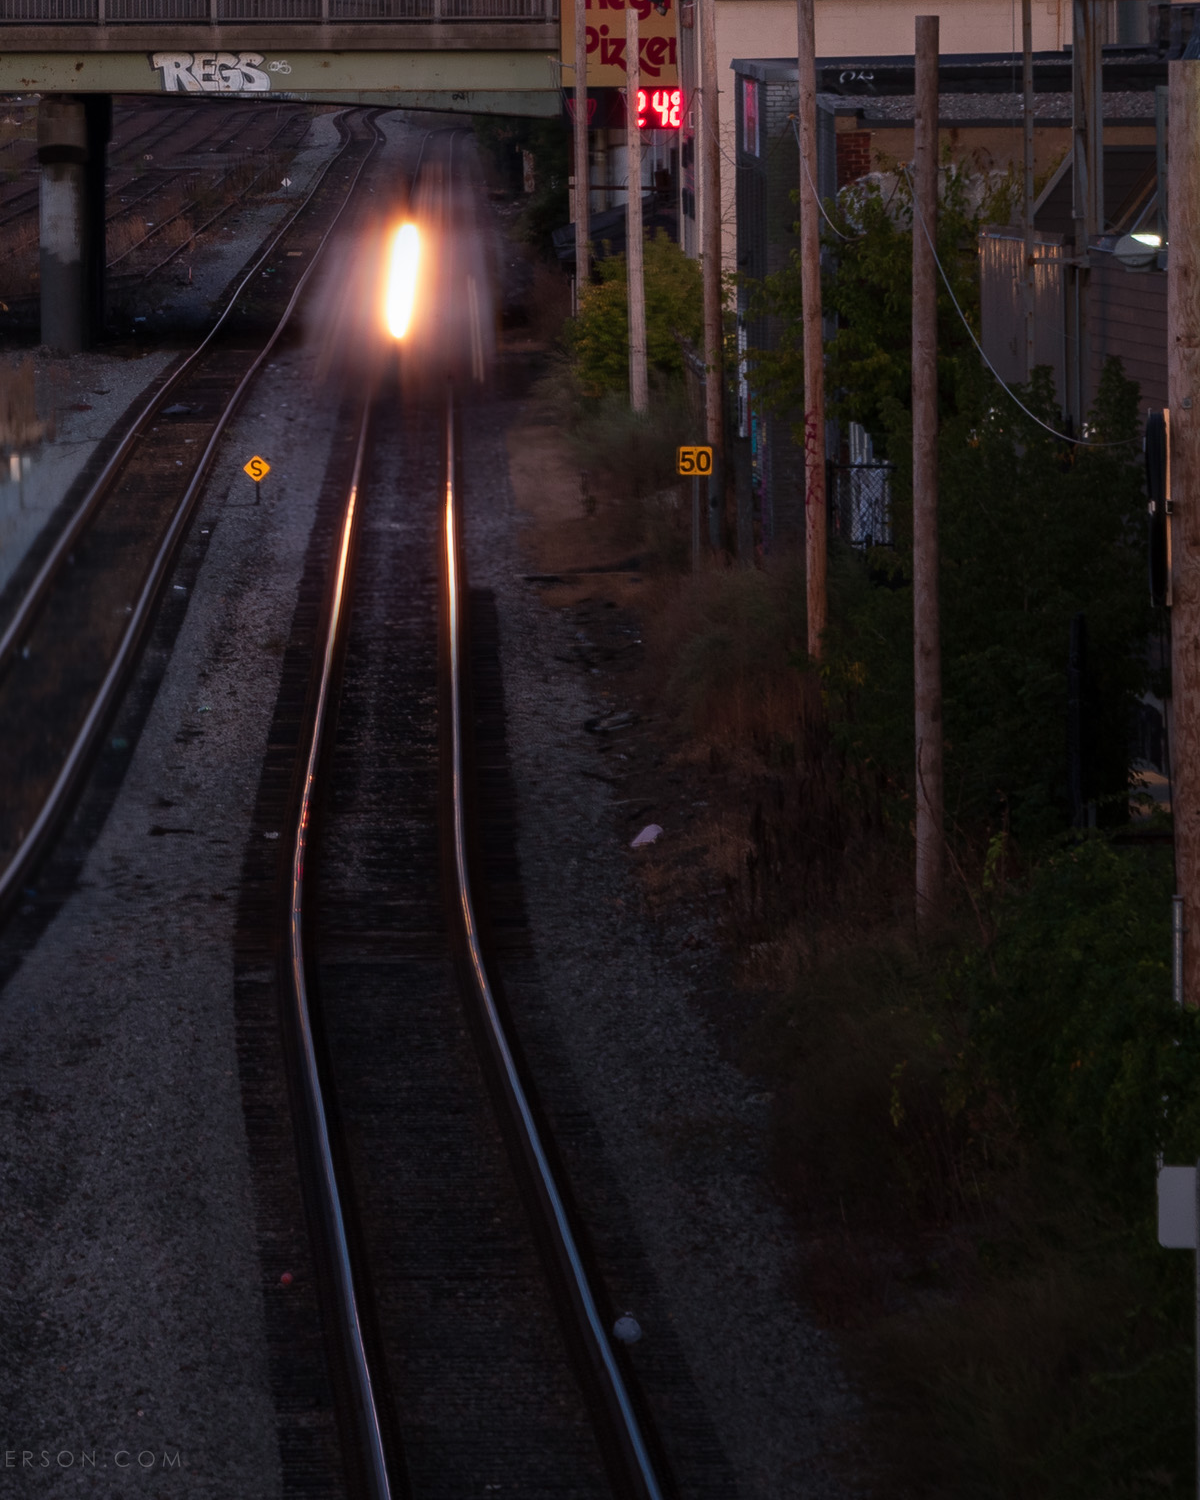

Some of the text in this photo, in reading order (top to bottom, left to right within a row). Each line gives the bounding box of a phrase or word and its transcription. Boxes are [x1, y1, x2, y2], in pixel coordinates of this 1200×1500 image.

[148, 51, 271, 91] REGS
[251, 460, 262, 476] S
[680, 451, 711, 472] 50
